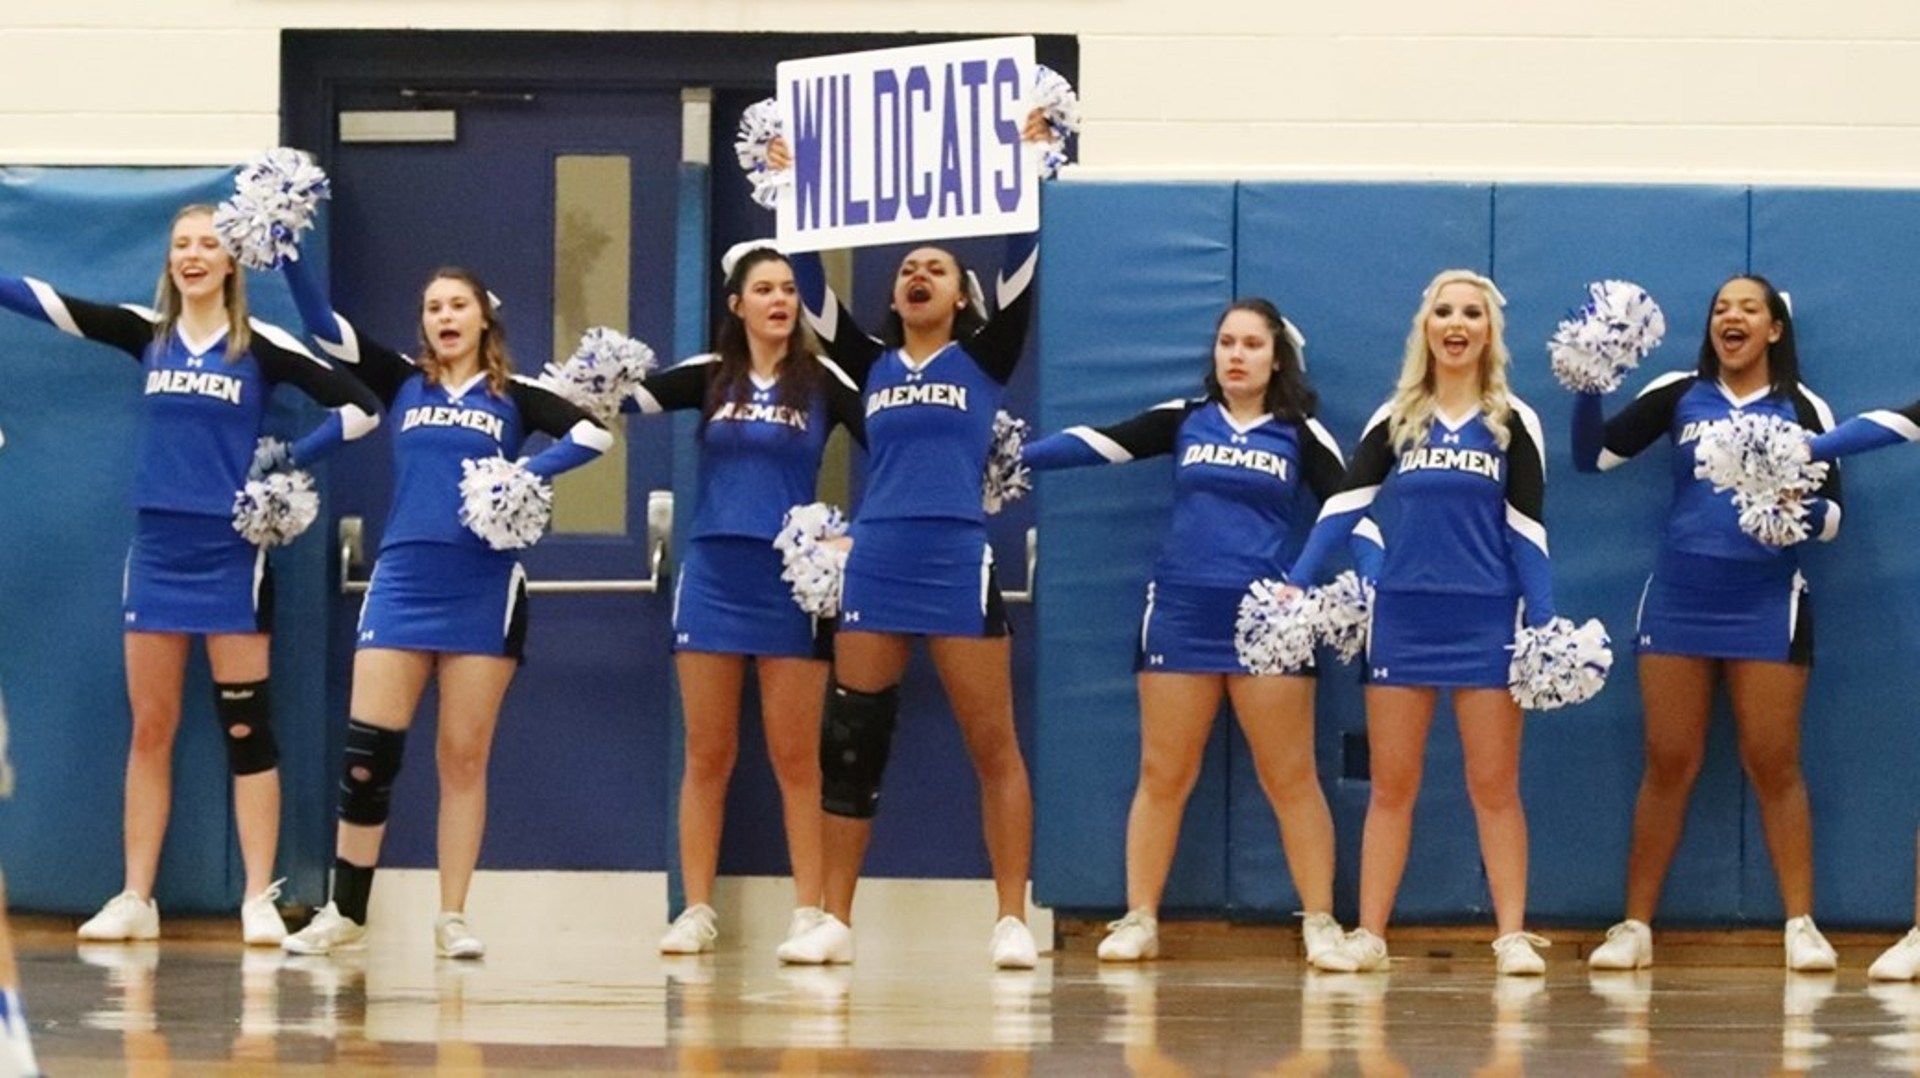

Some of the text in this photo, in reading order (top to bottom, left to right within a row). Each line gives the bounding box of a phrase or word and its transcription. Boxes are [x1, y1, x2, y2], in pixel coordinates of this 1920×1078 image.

[792, 57, 1022, 231] WILDCATS
[144, 369, 242, 405] DAEMEN
[865, 383, 967, 418] DAEMEN
[401, 406, 504, 442] DAEMEN
[1181, 443, 1287, 482] DAEMEN
[1398, 447, 1500, 482] DAEMEN
